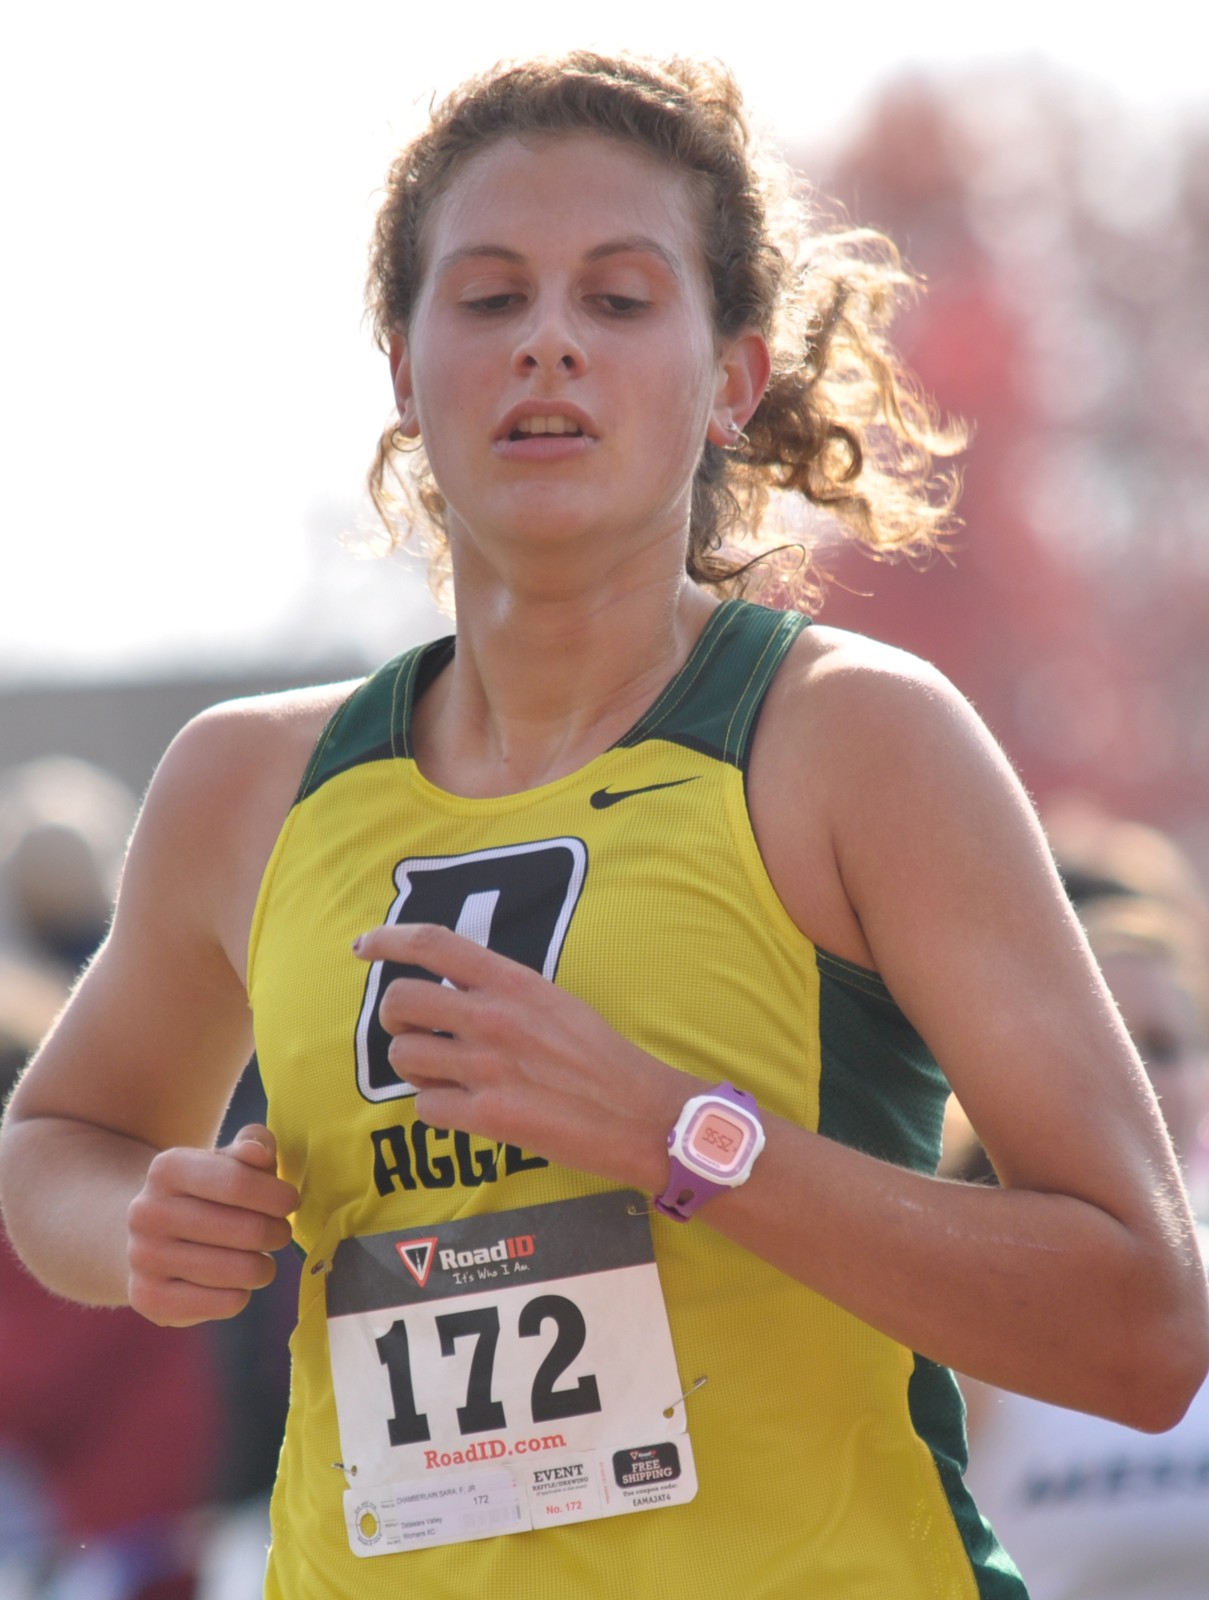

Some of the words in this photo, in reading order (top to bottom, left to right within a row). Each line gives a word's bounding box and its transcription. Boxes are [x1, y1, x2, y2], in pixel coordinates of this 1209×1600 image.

[438, 1235, 535, 1271] RoadID
[452, 1271, 475, 1285] It's
[477, 1267, 498, 1280] Who
[500, 1263, 510, 1276] I
[375, 1294, 602, 1447] 172
[424, 1433, 567, 1470] RoadID.com
[533, 1463, 584, 1484] EVENT
[631, 1459, 661, 1473] FREE
[622, 1467, 673, 1485] SHIPPING
[467, 1484, 476, 1493] JR
[623, 1490, 635, 1498] Use
[636, 1485, 659, 1496] coupon
[473, 1494, 489, 1505] 172
[545, 1504, 563, 1515] No.
[565, 1500, 583, 1512] 172
[426, 1517, 443, 1526] Valley
